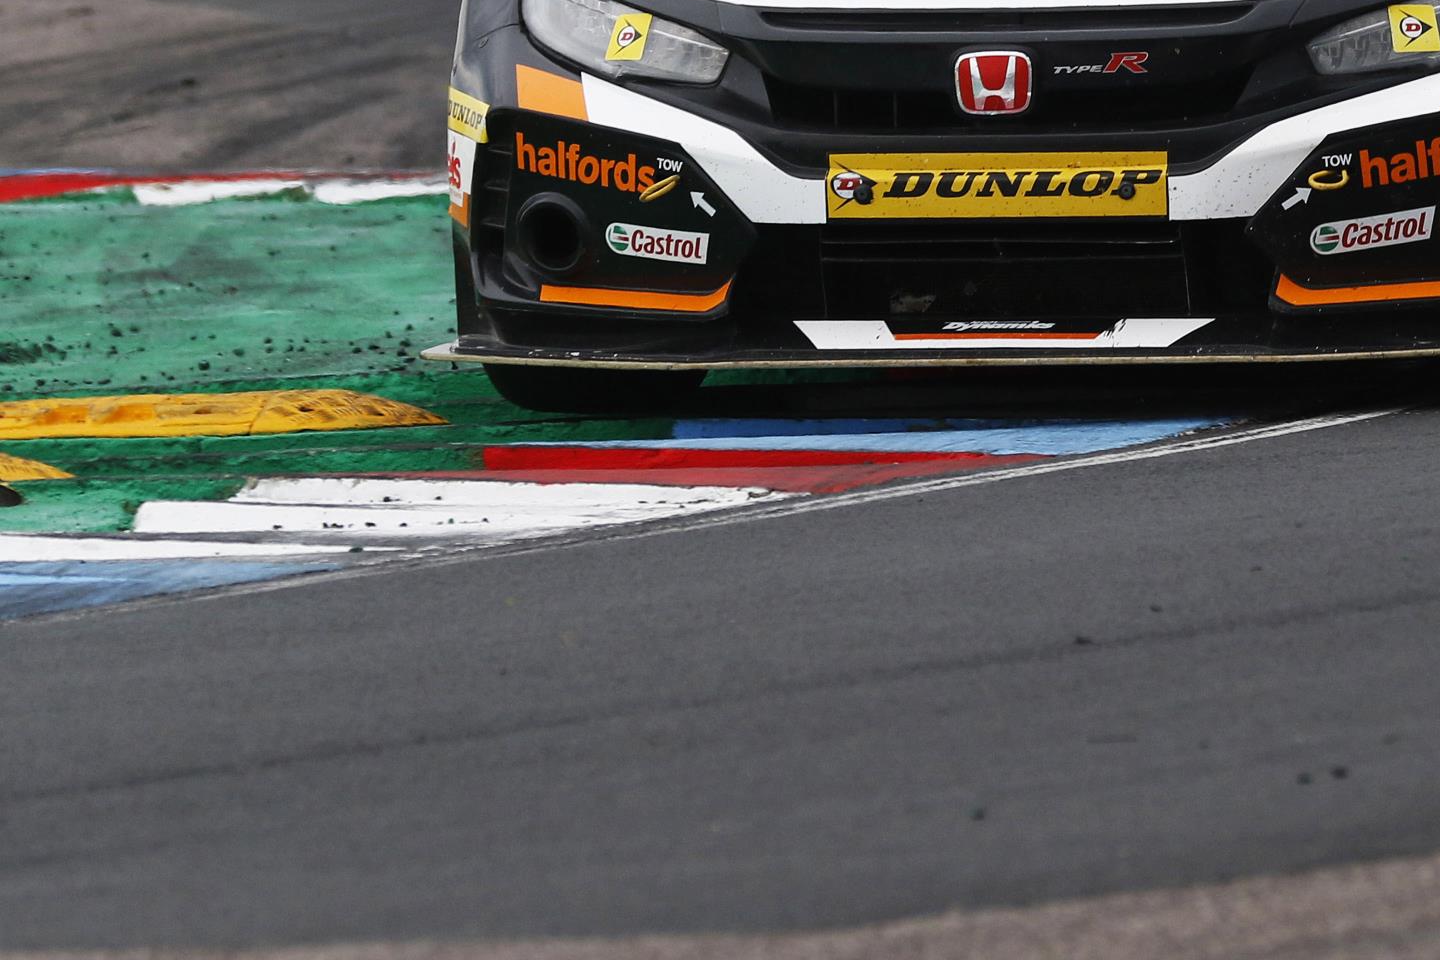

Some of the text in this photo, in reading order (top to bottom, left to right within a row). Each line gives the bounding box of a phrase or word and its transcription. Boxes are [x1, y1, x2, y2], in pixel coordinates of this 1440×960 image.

[1053, 51, 1149, 75] TYPE R
[516, 131, 657, 193] halfords
[656, 157, 683, 173] TOW
[1322, 153, 1352, 168] TOW
[882, 169, 1164, 198] DUNLOP
[1342, 211, 1427, 248] Castrol
[630, 229, 703, 259] Castrol
[942, 320, 1056, 331] Dynamics
